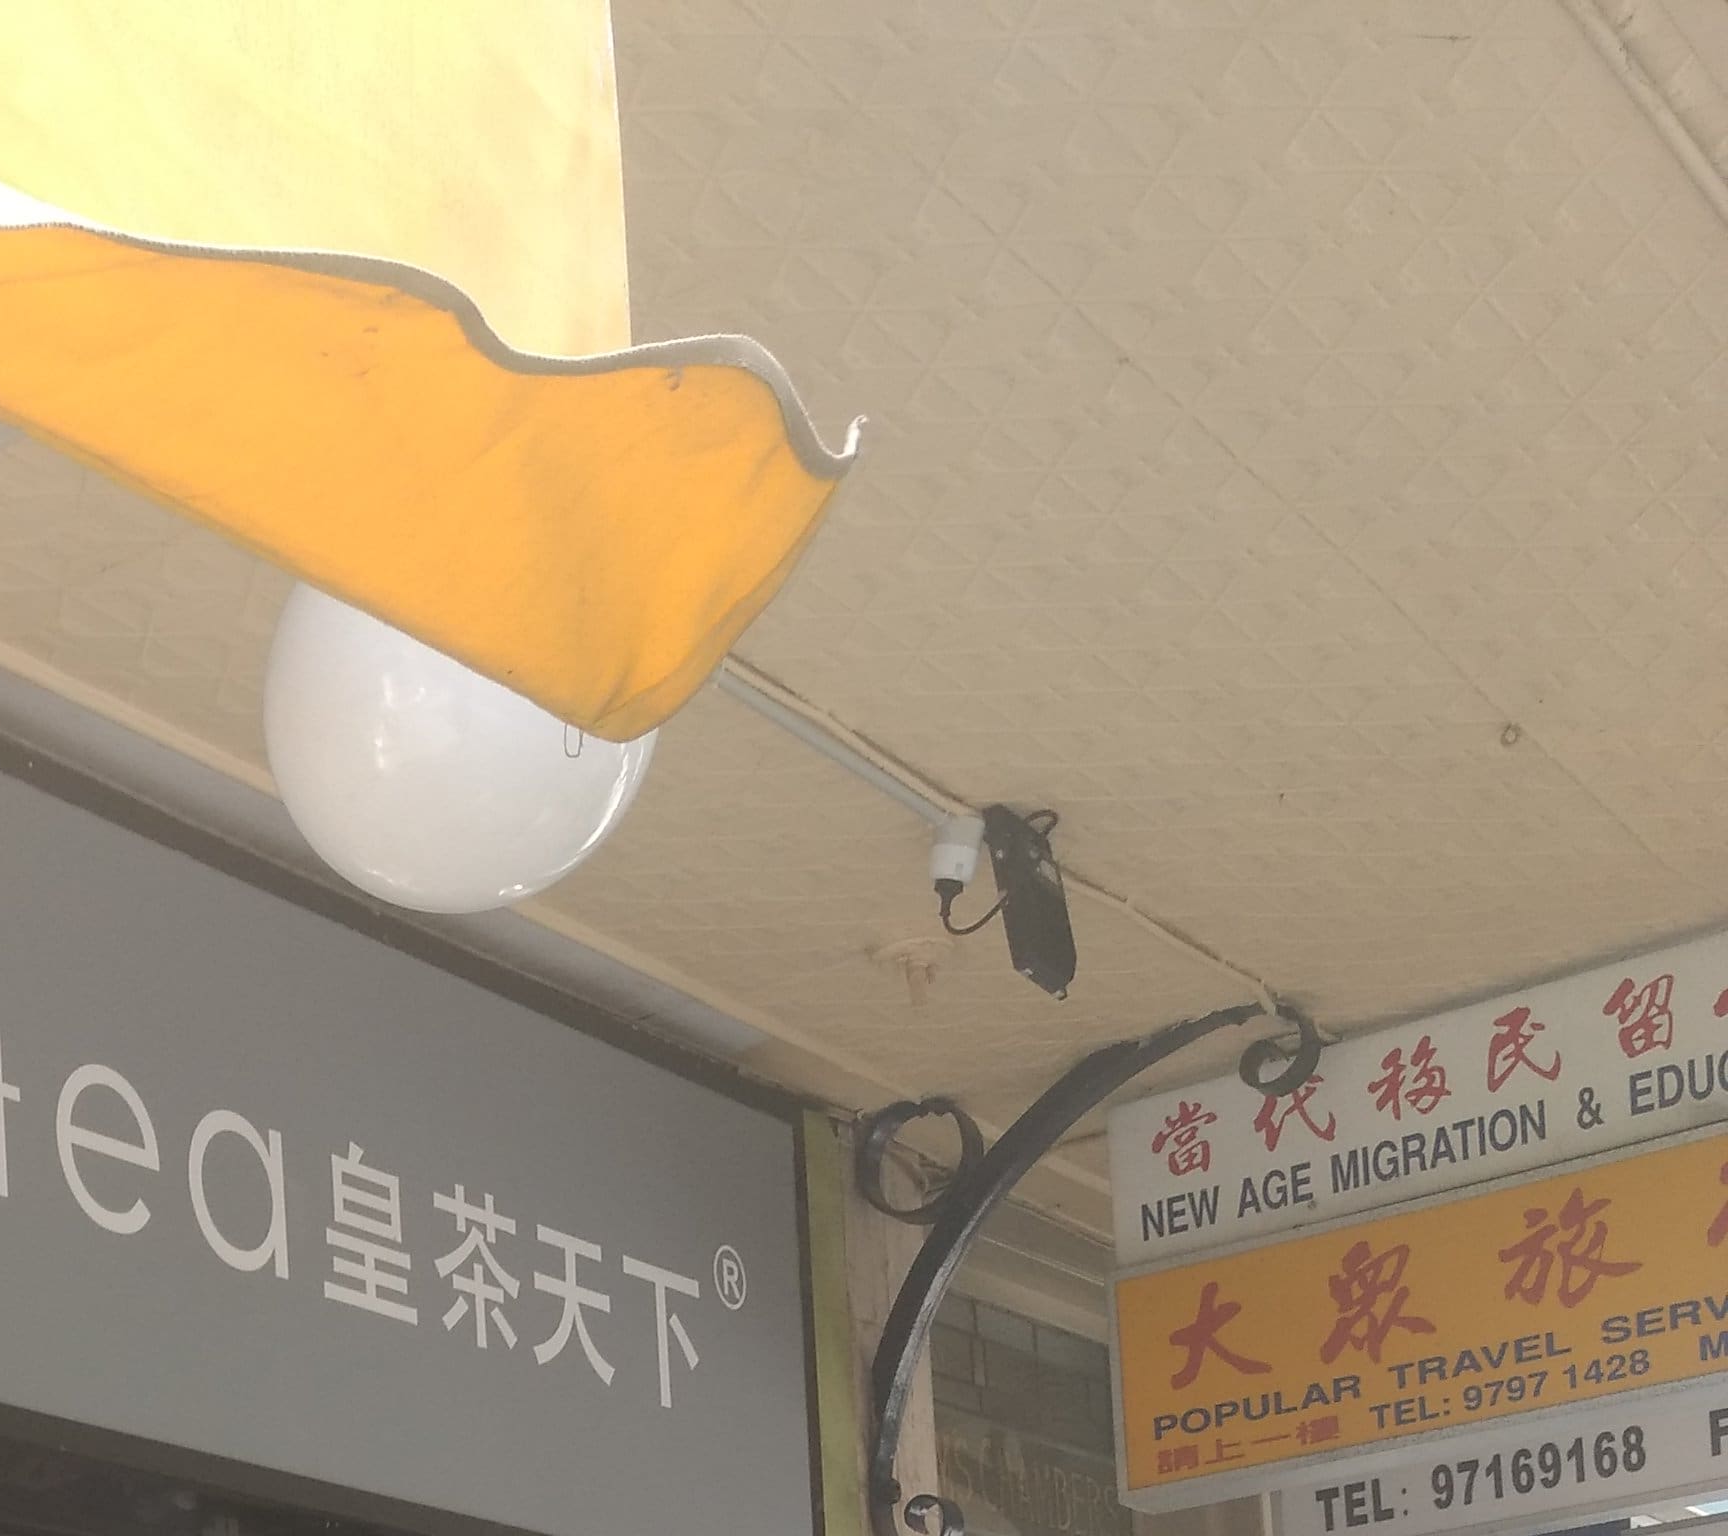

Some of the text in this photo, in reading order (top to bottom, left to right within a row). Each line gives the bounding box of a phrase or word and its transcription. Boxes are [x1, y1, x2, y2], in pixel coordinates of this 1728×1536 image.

[1141, 1186, 1219, 1241] NEW
[1237, 1162, 1315, 1218] AGE
[1331, 1100, 1546, 1194] MIGRATION
[1577, 1087, 1604, 1130] &
[1153, 1375, 1361, 1440] POPULAR
[1388, 1332, 1572, 1390] TRAVEL
[1369, 1397, 1451, 1430] TEL:
[1463, 1371, 1548, 1411] 9797
[1563, 1350, 1650, 1389] 1428
[1316, 1481, 1410, 1533] TEL:
[1432, 1426, 1647, 1509] 97169168
